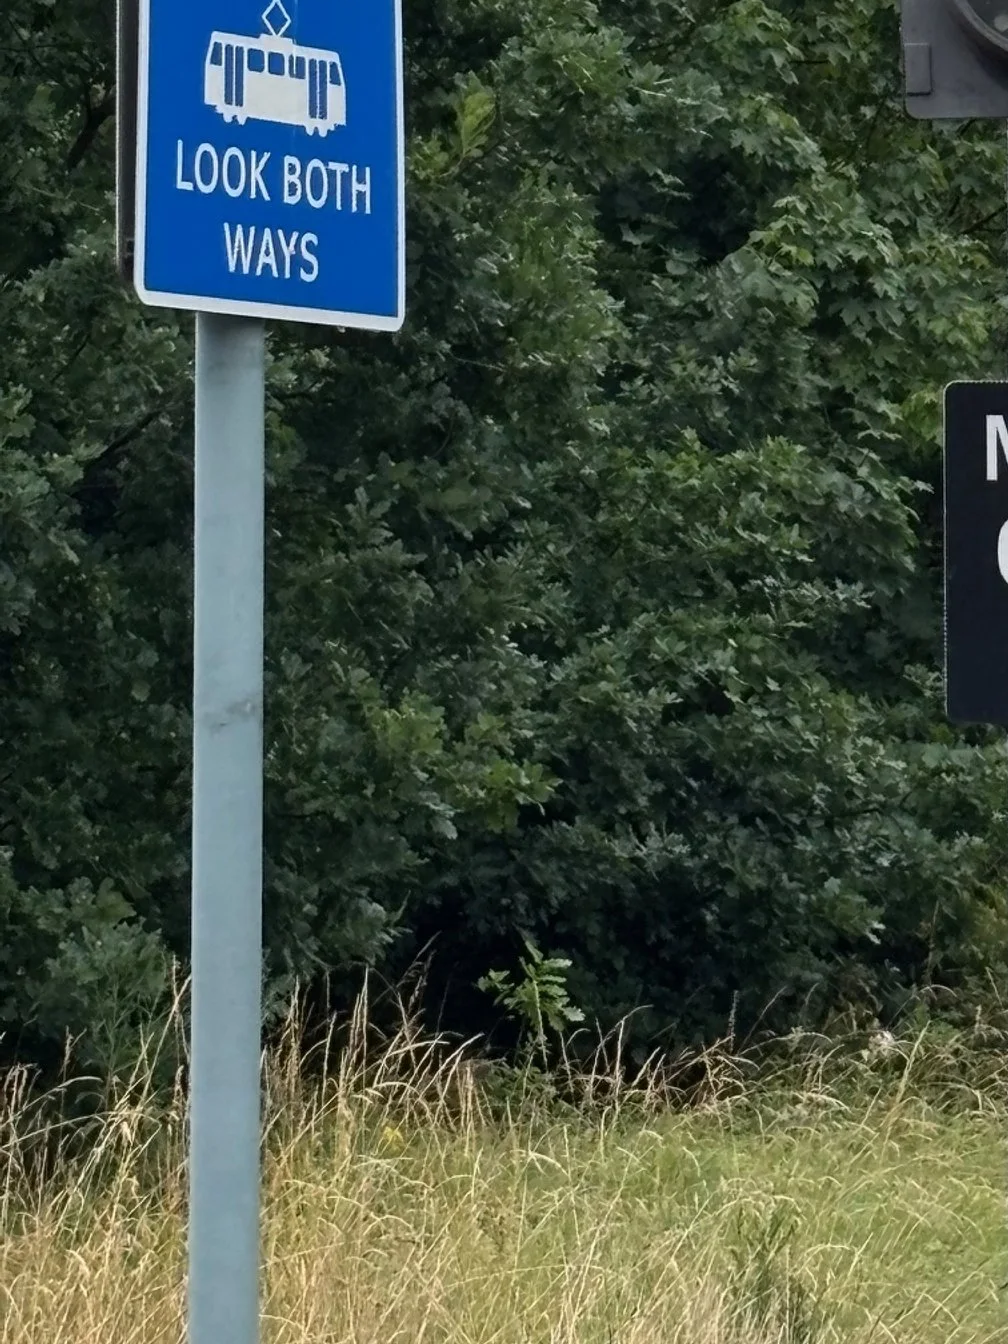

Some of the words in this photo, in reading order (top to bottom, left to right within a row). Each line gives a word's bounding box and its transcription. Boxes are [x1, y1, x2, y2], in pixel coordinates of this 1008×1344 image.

[175, 139, 271, 202] LOOK
[283, 155, 372, 215] BOTH
[223, 222, 319, 283] WAYS
